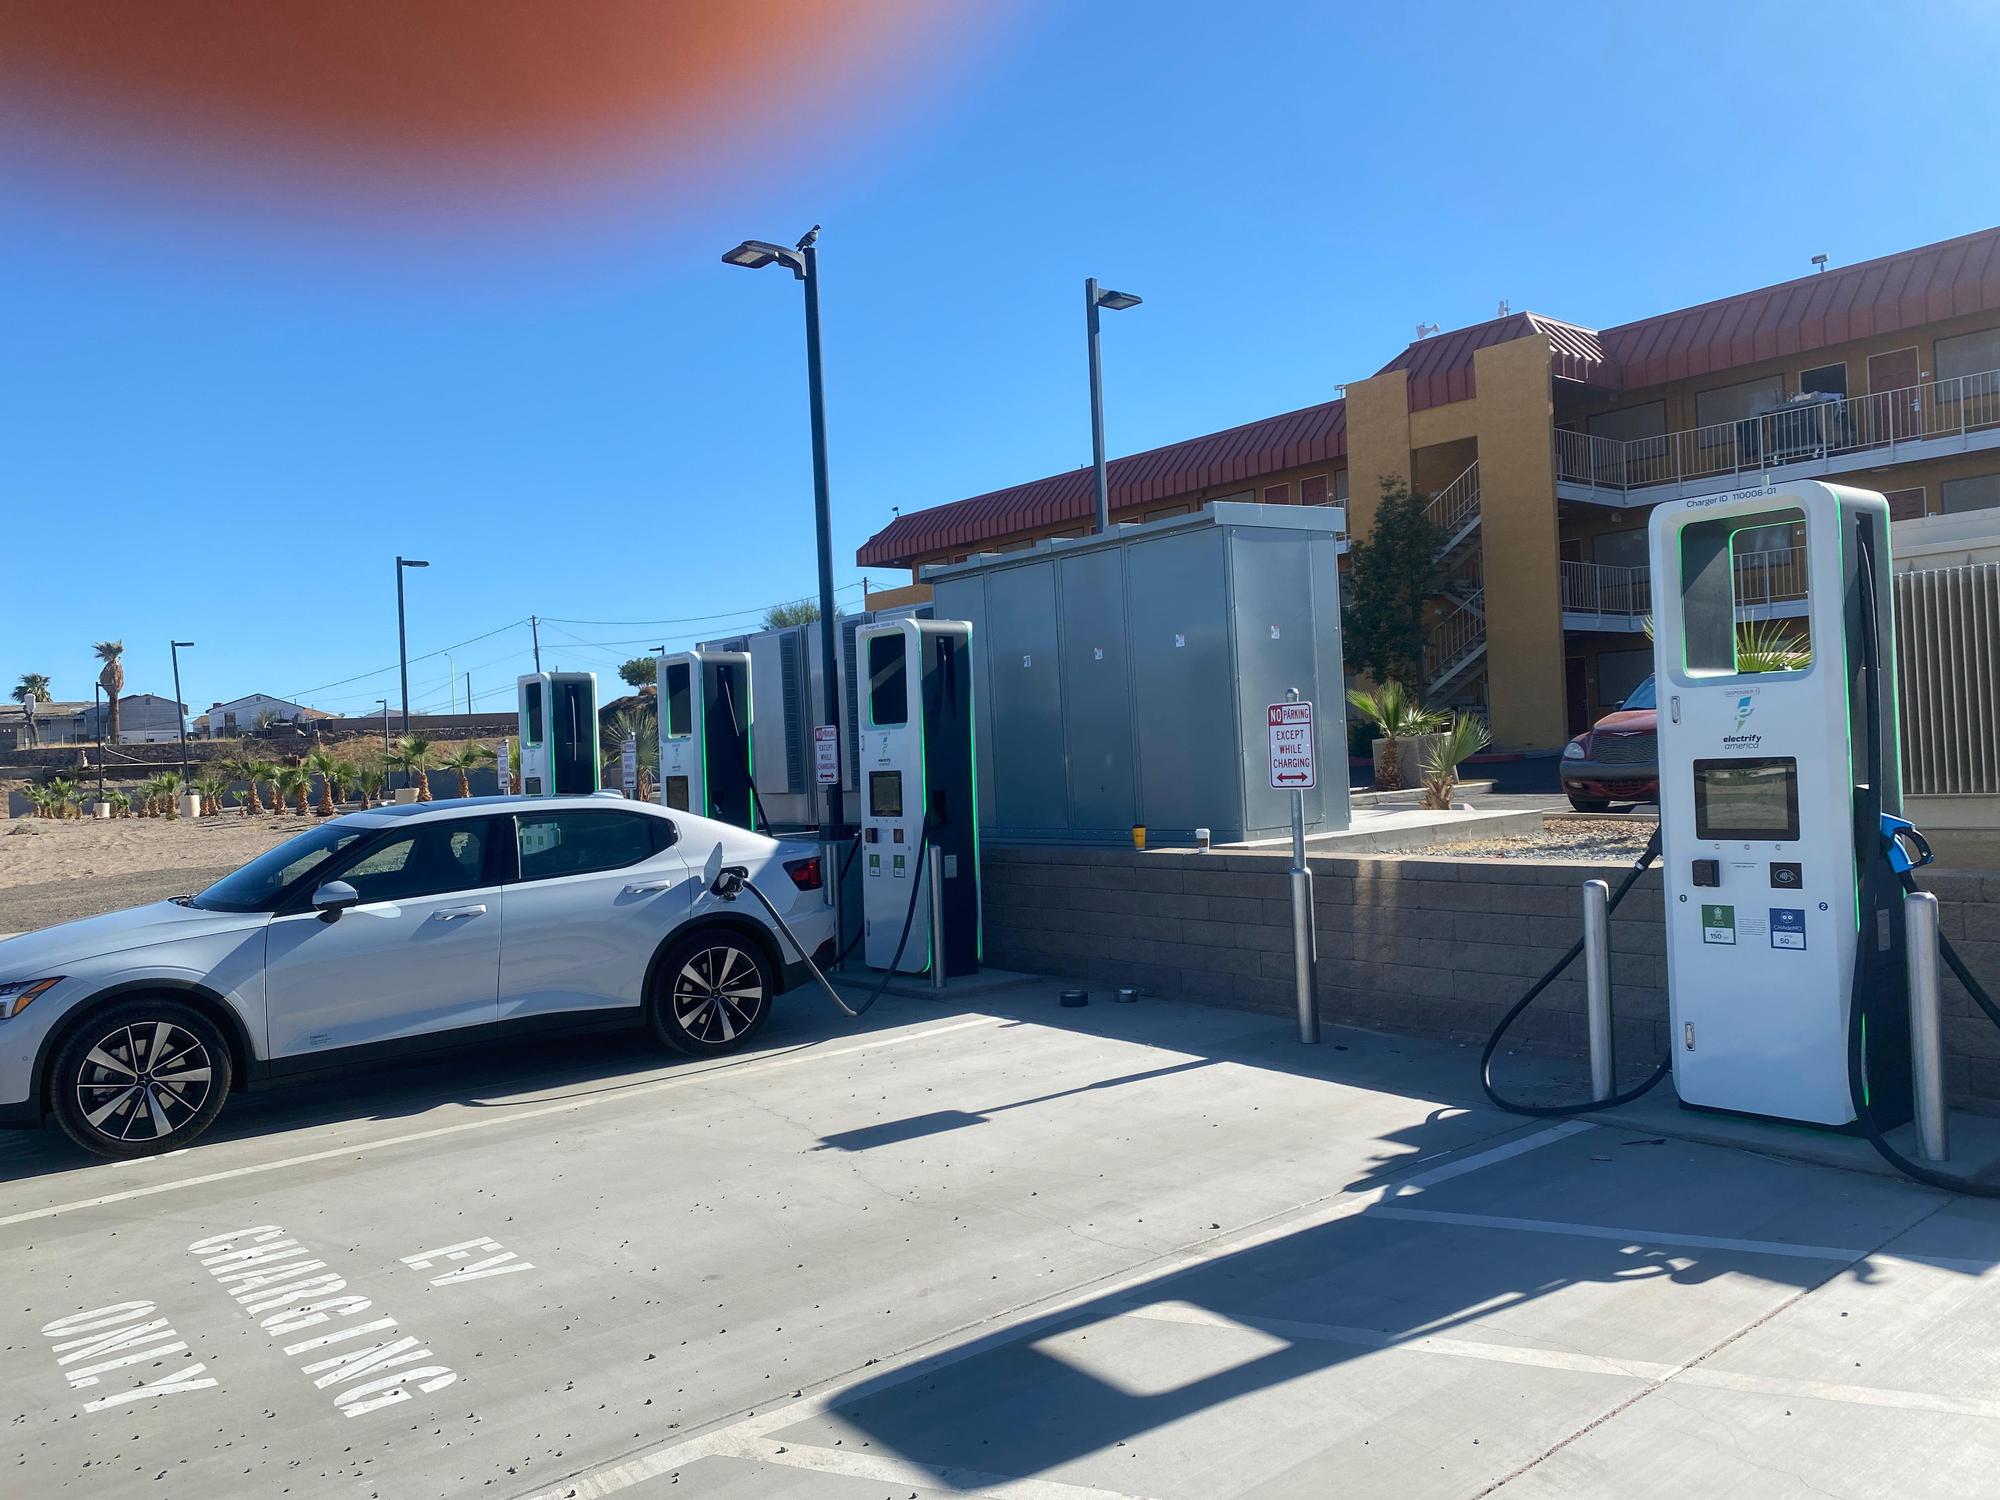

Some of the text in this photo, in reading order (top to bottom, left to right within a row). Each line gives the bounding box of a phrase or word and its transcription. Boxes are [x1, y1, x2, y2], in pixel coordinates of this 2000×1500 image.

[1686, 487, 1776, 508] Charger ID 110008-01
[1270, 708, 1309, 722] NO PARKING
[1276, 730, 1304, 740] EXCEPT
[1723, 734, 1762, 743] electrify
[1279, 744, 1302, 754] WHILE
[1273, 758, 1310, 768] CHARGING
[400, 1236, 537, 1287] EV
[187, 1224, 458, 1419] CHARGING
[41, 1300, 219, 1414] ONLY
